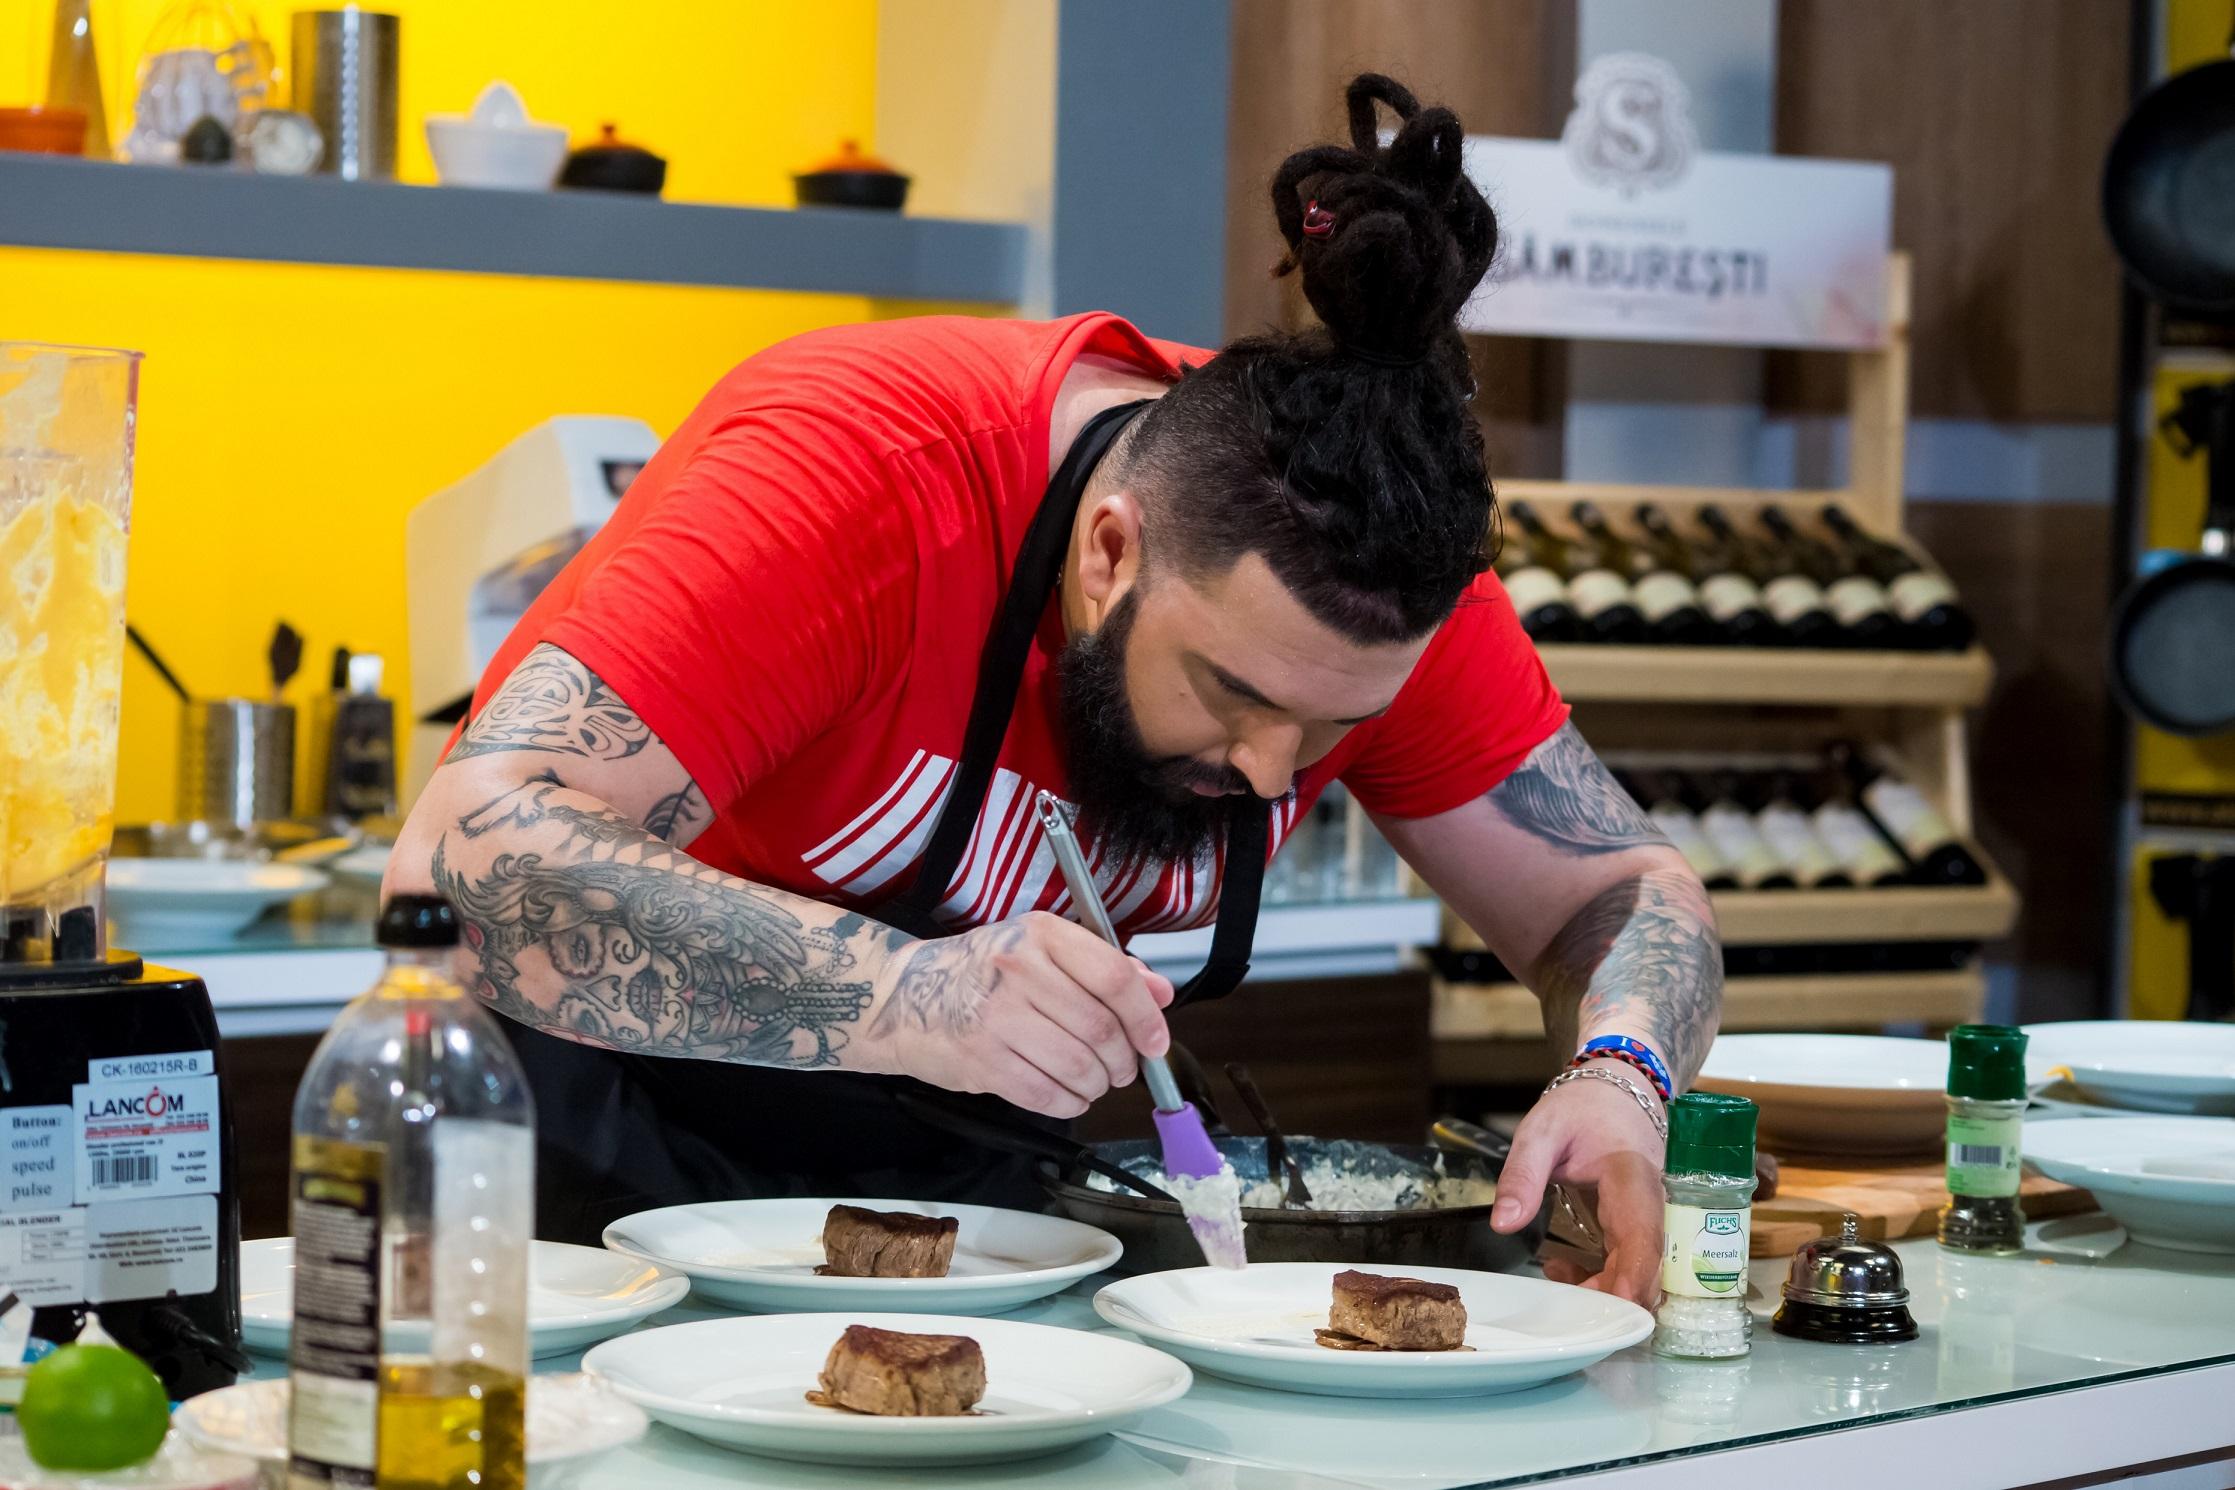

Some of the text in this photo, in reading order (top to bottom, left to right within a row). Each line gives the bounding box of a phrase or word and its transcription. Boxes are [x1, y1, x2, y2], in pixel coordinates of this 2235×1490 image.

[1495, 232, 1769, 300] ÂMBUREȘTI
[101, 1058, 198, 1077] CK-160215R-B
[89, 1090, 184, 1118] LANCOM
[12, 1117, 61, 1128] Button:
[12, 1135, 50, 1149] on/off
[12, 1156, 55, 1176] speed
[184, 1174, 207, 1184] China
[12, 1182, 52, 1202] pulse
[18, 1214, 61, 1225] BLENDER
[1709, 1217, 1737, 1228] FUCHS
[1702, 1249, 1738, 1258] Meersalz
